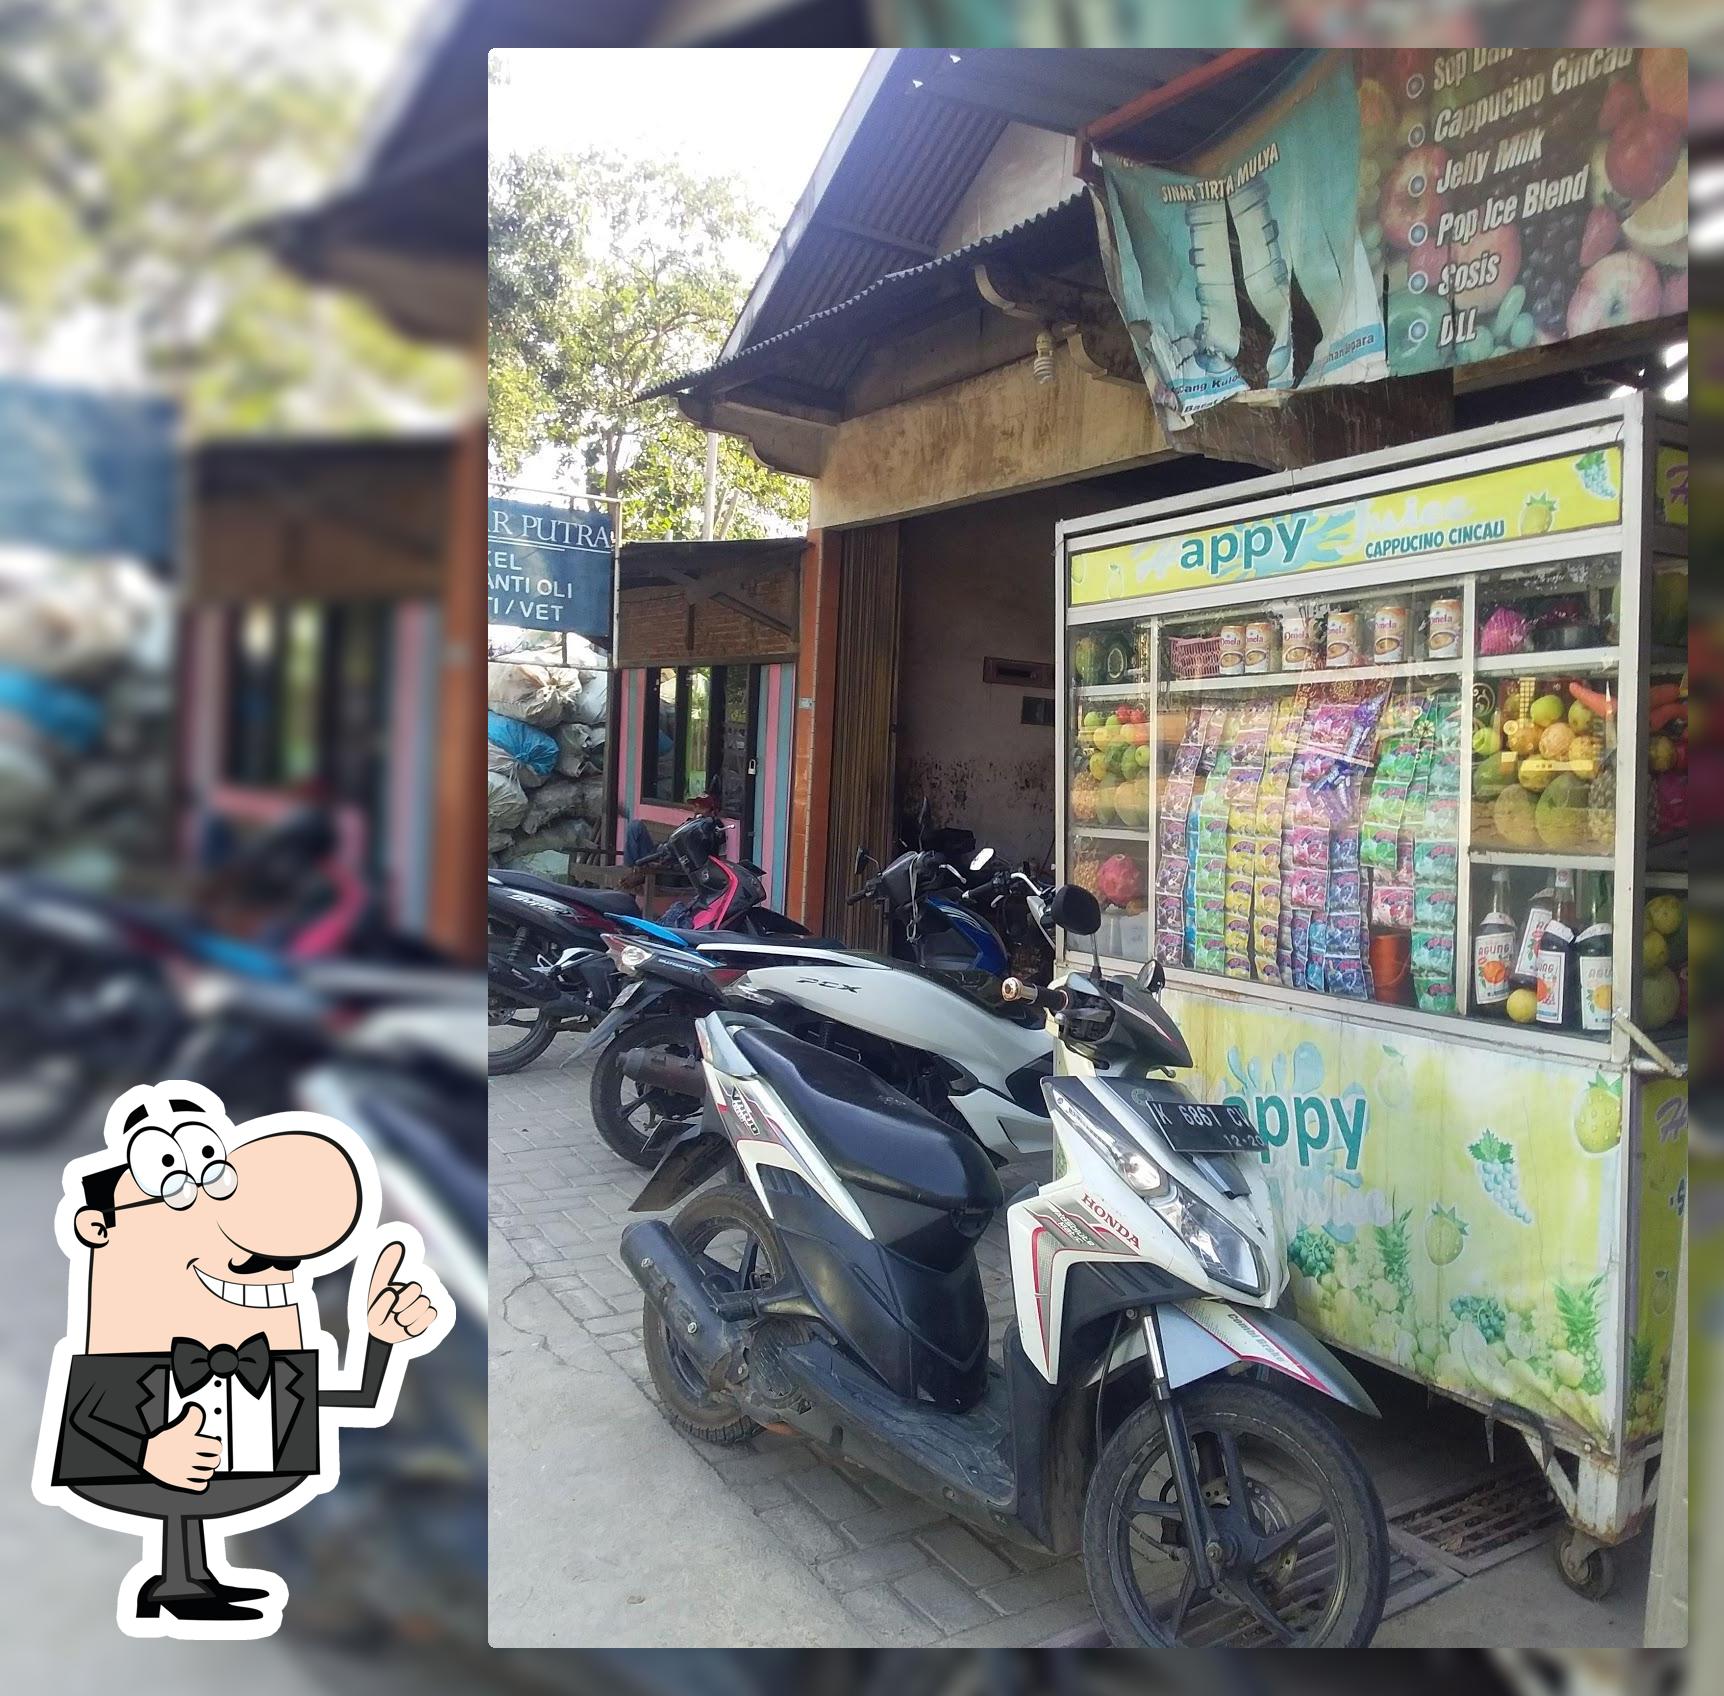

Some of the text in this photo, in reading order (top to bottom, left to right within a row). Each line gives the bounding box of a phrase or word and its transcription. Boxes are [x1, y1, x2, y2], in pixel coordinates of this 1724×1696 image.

[1433, 50, 1467, 91] Sop
[1434, 48, 1633, 143] Cappucino Cincau
[1161, 142, 1280, 203] SINAR TIRTA MULYA
[1436, 125, 1545, 194] Jelly Milk
[1436, 163, 1590, 247] Pop Ice Blend
[1437, 252, 1500, 296] Sosis
[1439, 307, 1477, 348] DLL
[488, 511, 612, 549] R PUTRA
[1365, 520, 1505, 559] CAPPUCINO CINCAU
[537, 579, 572, 599] OLI
[519, 601, 564, 621] VET
[796, 977, 862, 994] PCX
[1153, 1103, 1172, 1126] K
[1179, 1105, 1222, 1128] 6861
[1082, 1192, 1140, 1250] HONDA
